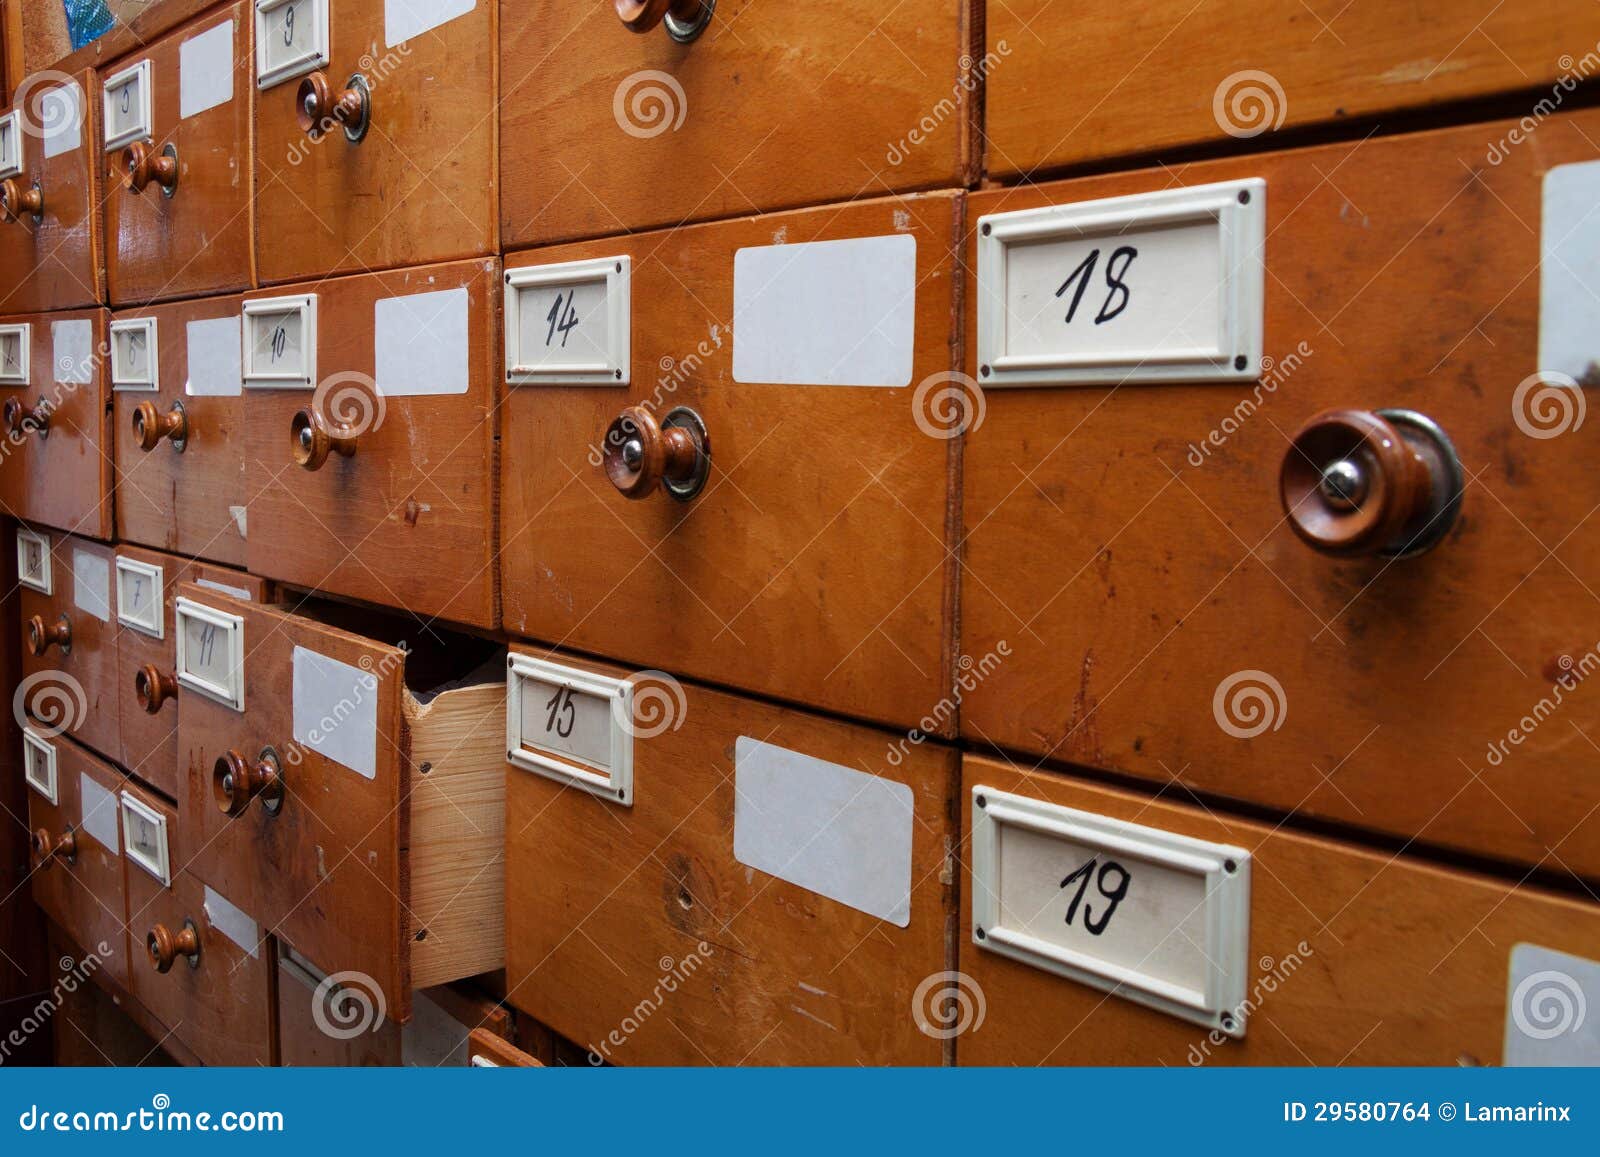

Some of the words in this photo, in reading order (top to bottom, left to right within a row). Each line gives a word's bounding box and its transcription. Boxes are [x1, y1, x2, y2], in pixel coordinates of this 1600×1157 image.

[284, 6, 295, 47] 9
[1055, 245, 1138, 326] 18
[546, 289, 579, 347] 14
[271, 325, 286, 364] 10
[134, 579, 141, 608] 7
[200, 622, 216, 666] 11
[546, 683, 577, 738] 15
[1060, 858, 1132, 936] 19
